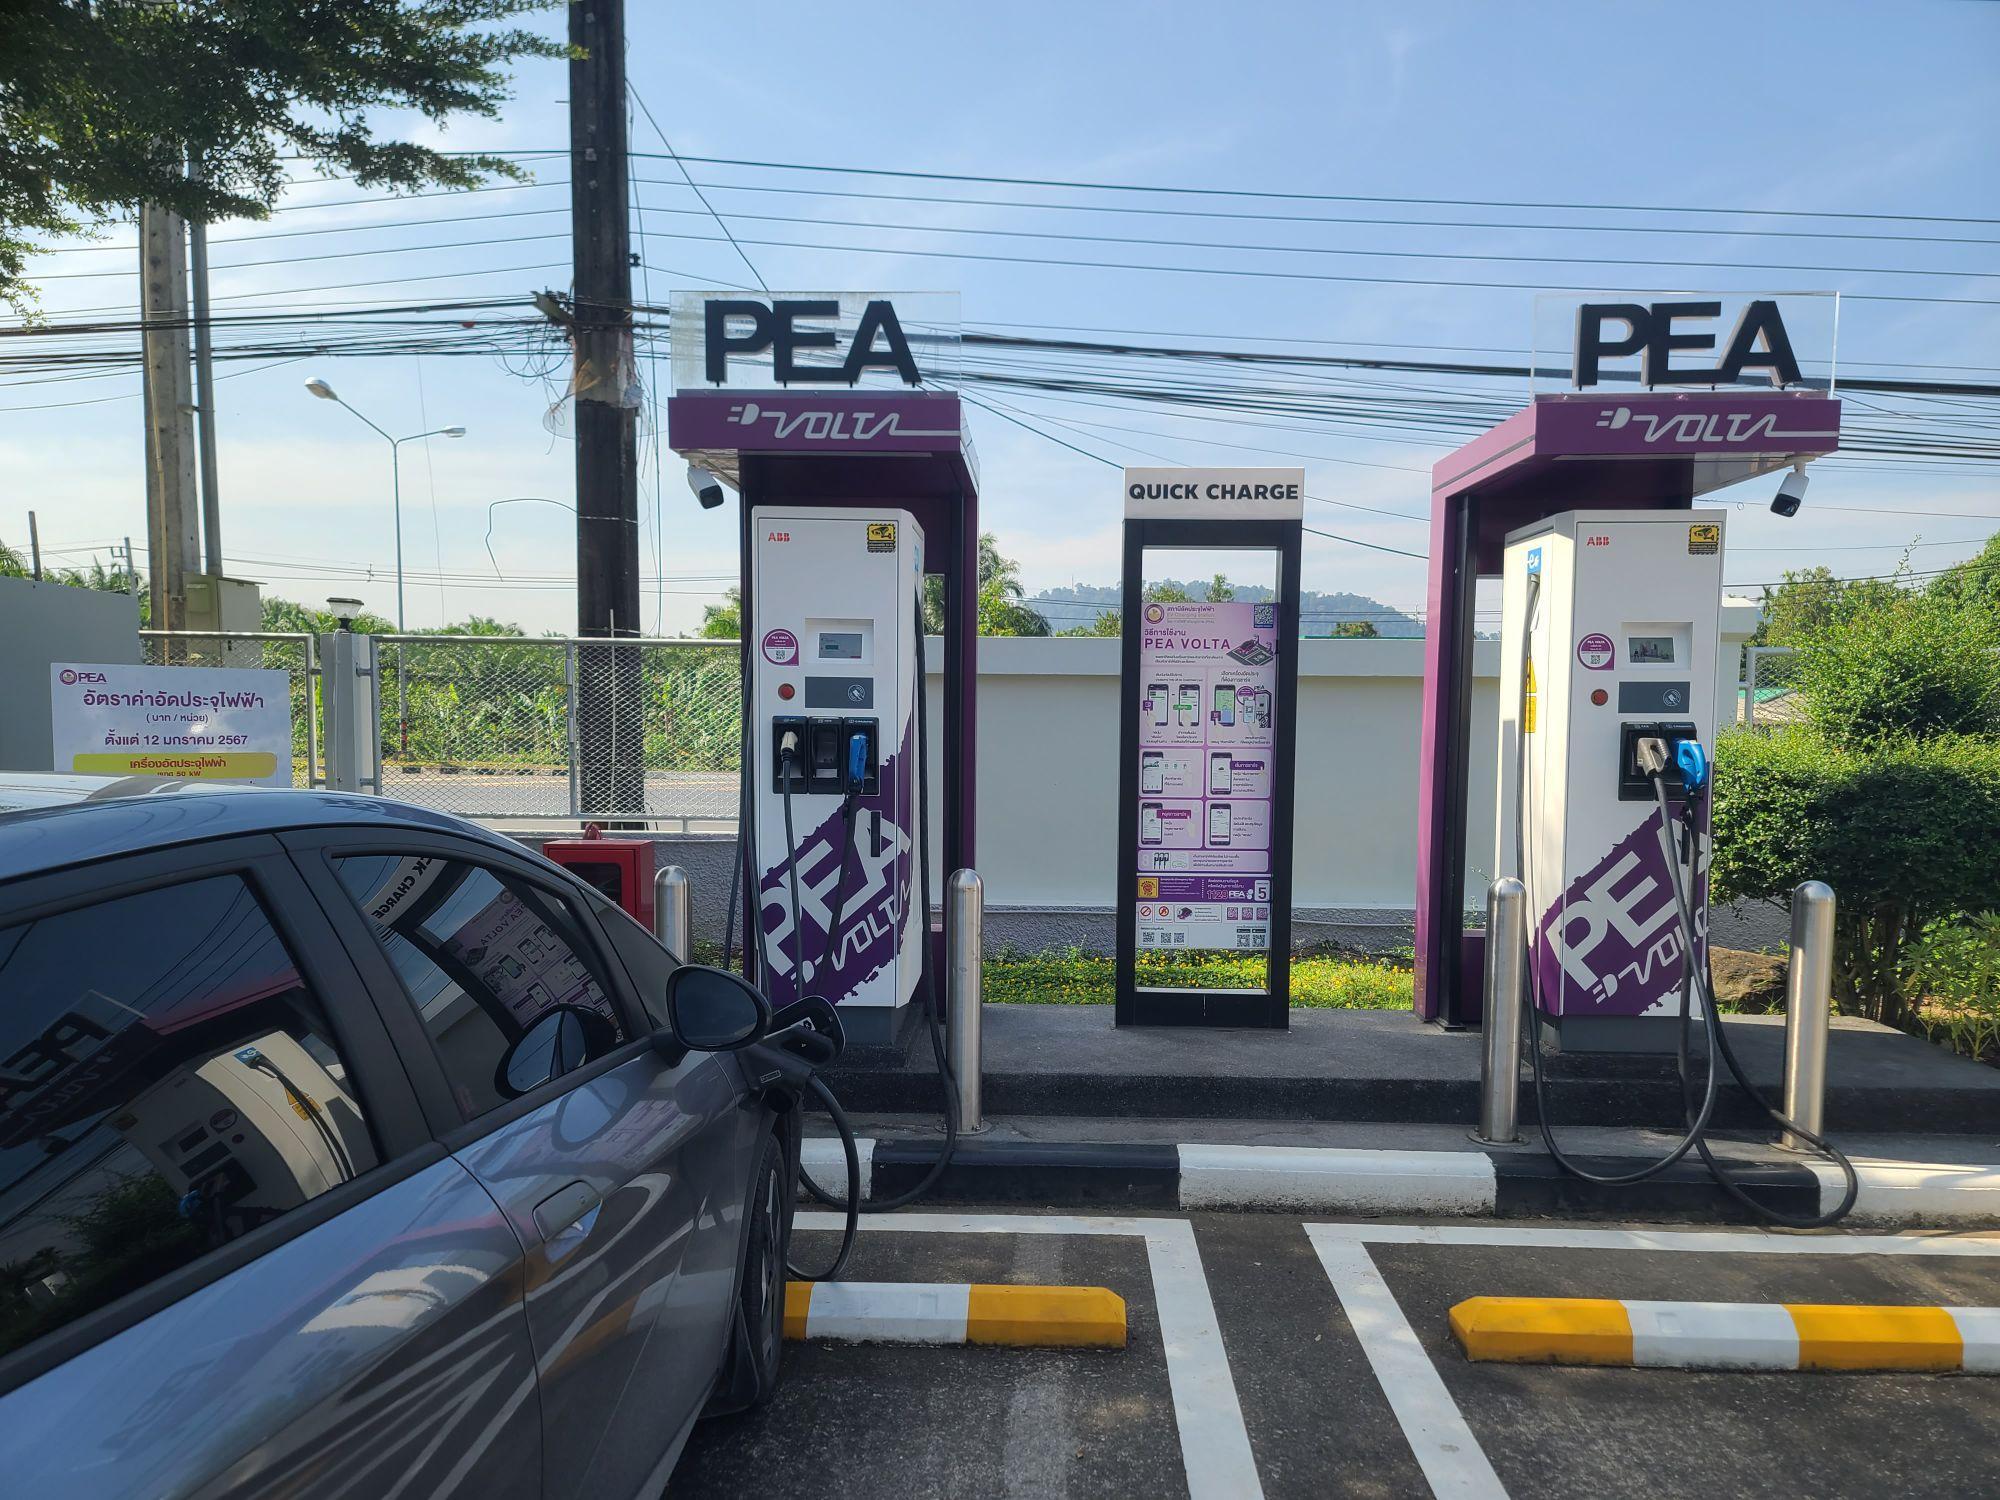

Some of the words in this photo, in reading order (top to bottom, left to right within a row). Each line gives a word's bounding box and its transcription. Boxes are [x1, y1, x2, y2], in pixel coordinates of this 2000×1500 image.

[705, 300, 922, 384] PEA
[1572, 300, 1803, 387] PEA
[762, 411, 903, 440] VOLTA
[1632, 413, 1778, 443] VOLTA
[1129, 483, 1199, 500] QUICK
[1206, 484, 1299, 500] CHARGE
[768, 532, 790, 542] ABB
[1586, 536, 1610, 547] ABB
[1144, 638, 1175, 649] PEA
[1182, 638, 1231, 649] VOLTA
[78, 672, 107, 683] PEA
[83, 690, 264, 712] อัตราค่าอัดประจุไฟฟ้า
[105, 729, 139, 746] ตั้งแต่
[144, 735, 159, 745] 12
[163, 735, 214, 746] มกราคม
[218, 735, 248, 745] 2567
[130, 756, 226, 771] เครื่องอัดประจุไฟฟ้า
[760, 807, 911, 977] PEA
[1258, 887, 1267, 899] 5
